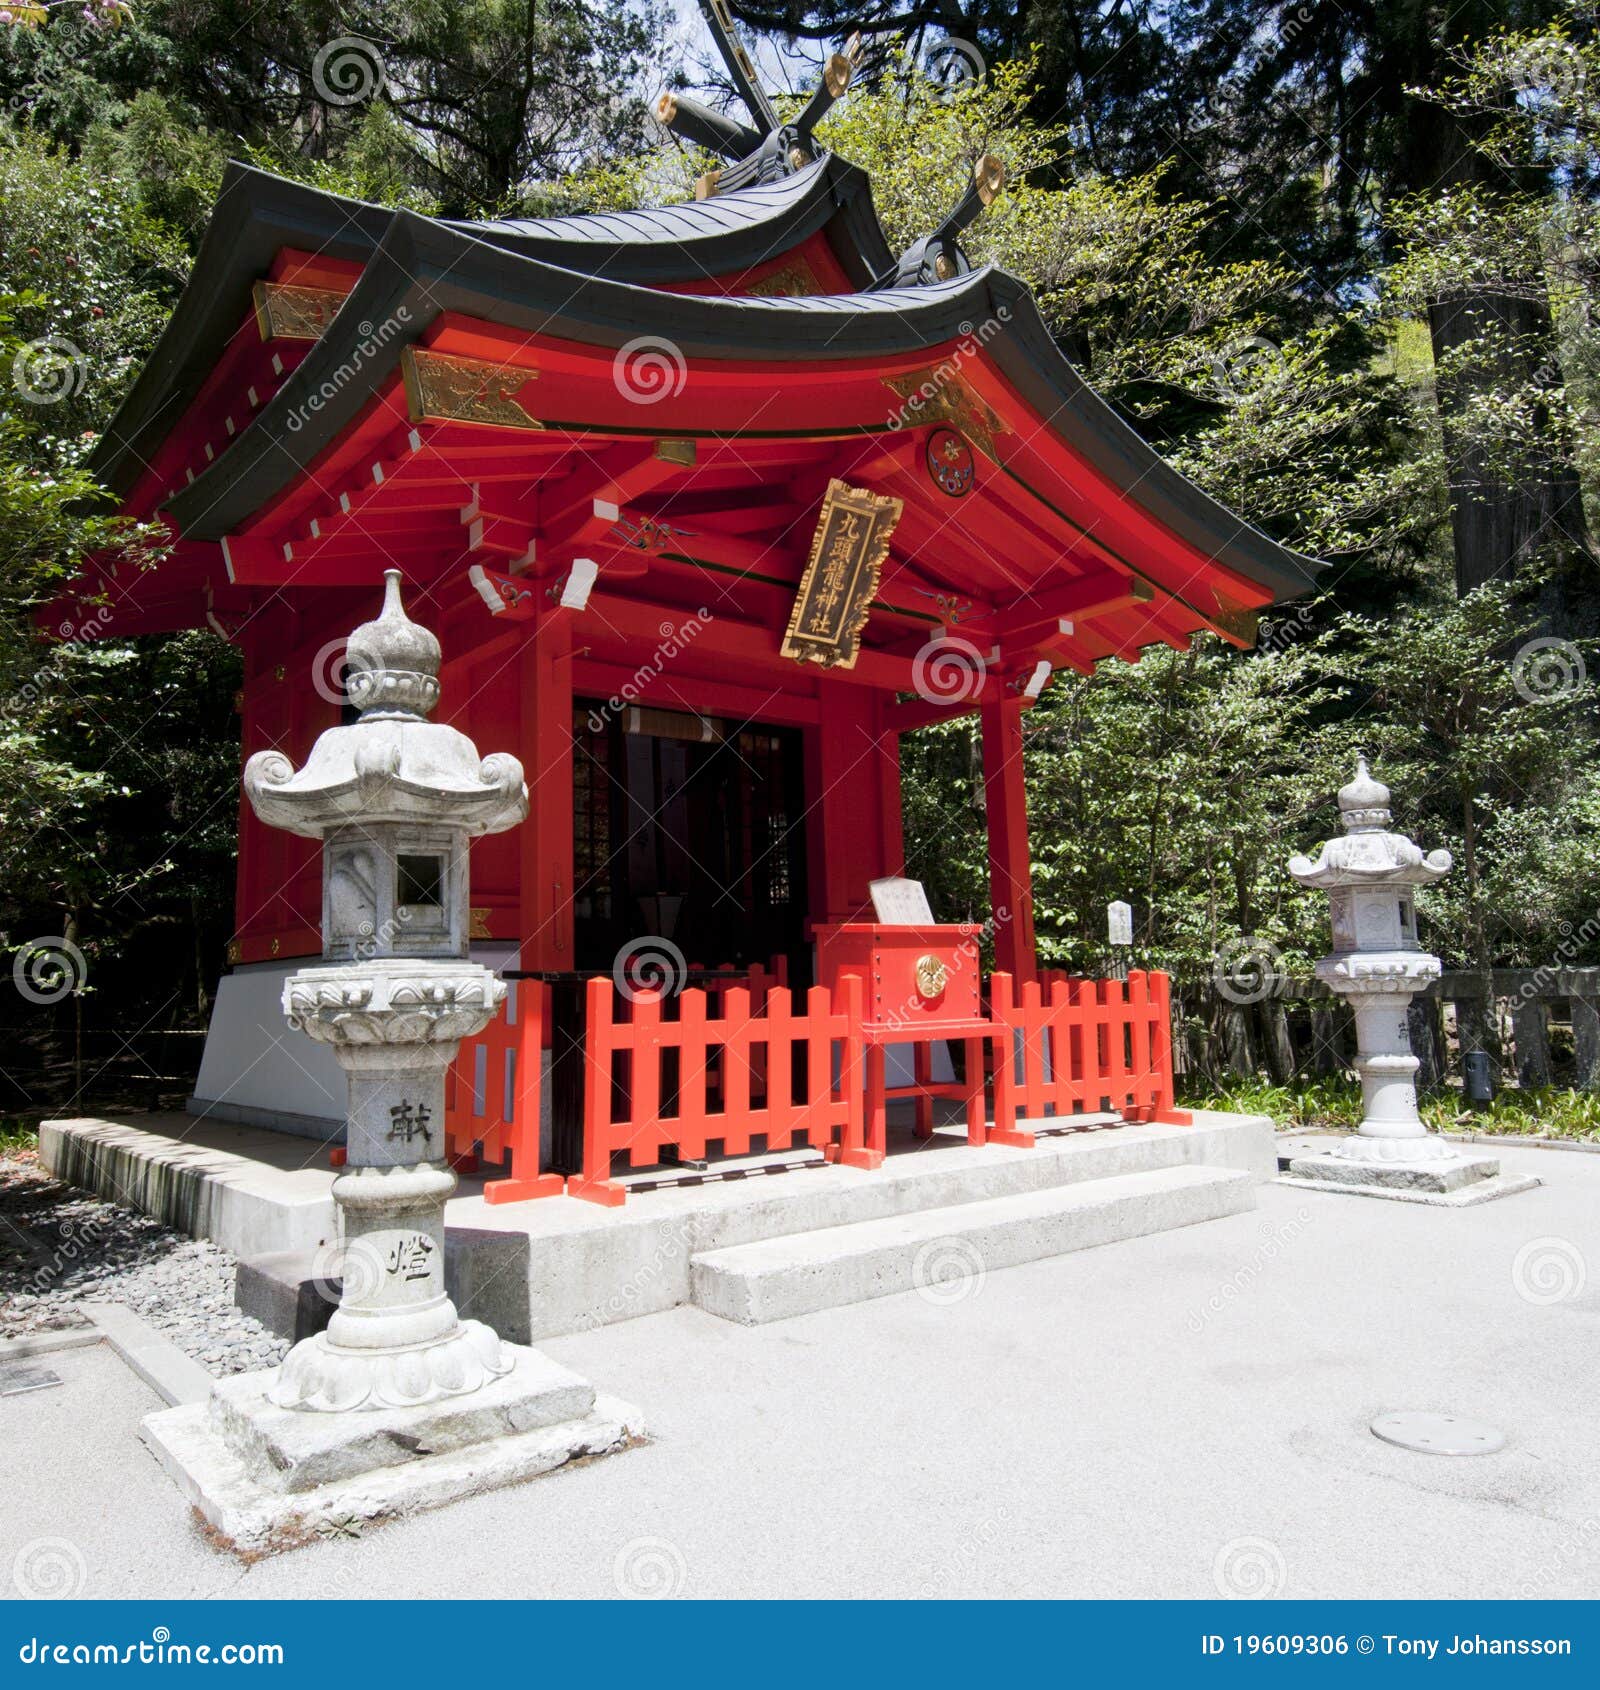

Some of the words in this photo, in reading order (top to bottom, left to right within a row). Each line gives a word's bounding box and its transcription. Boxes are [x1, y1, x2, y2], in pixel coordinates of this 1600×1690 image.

[808, 512, 860, 635] 九頭龍神社
